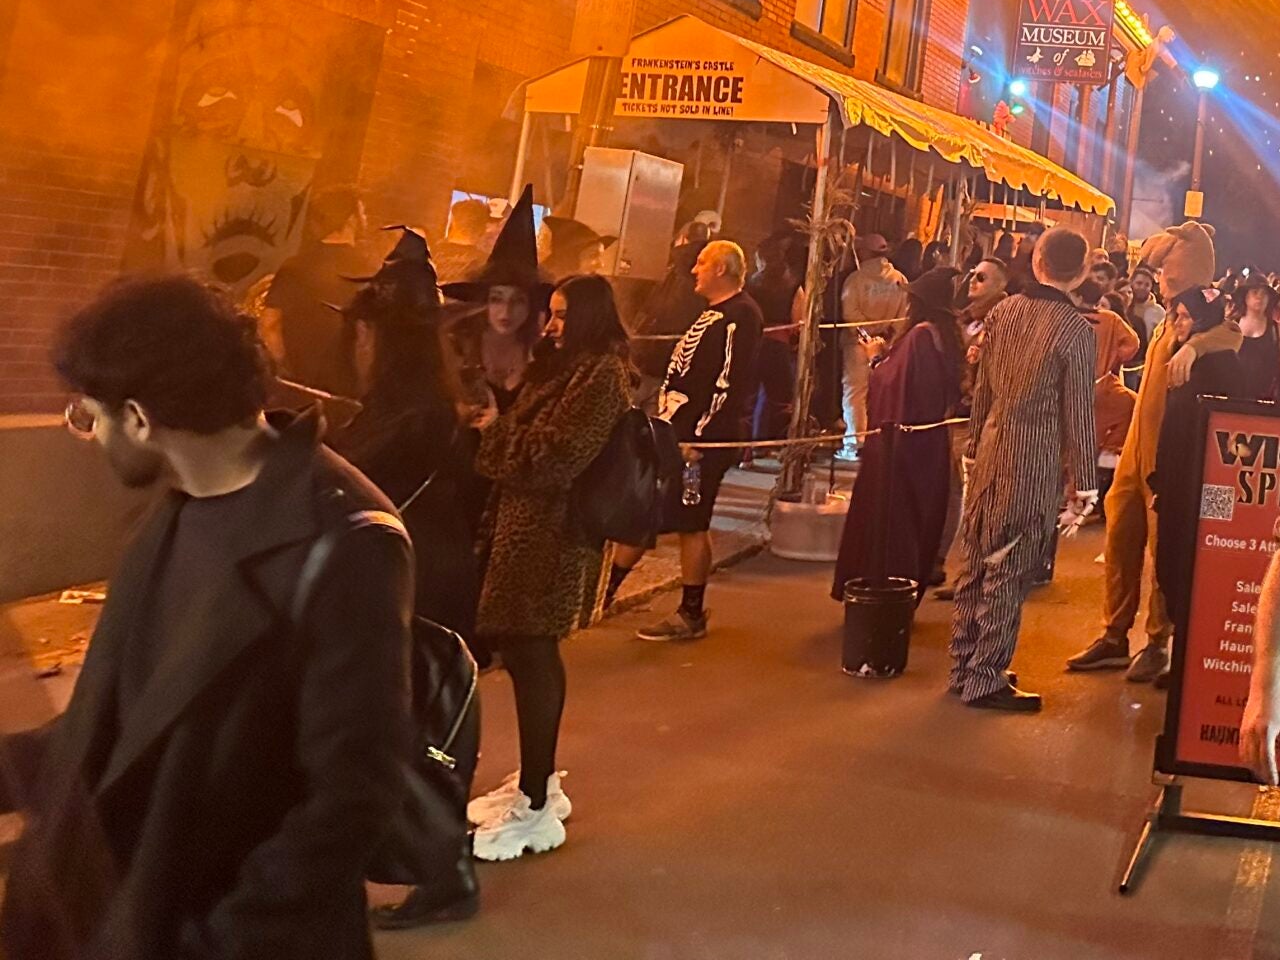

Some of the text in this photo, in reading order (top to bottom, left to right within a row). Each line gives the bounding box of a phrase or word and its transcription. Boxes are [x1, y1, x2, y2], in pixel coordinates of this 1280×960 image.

[1020, 26, 1106, 46] MUSEUM
[1053, 48, 1070, 66] of
[631, 58, 735, 71] FRANKENSTEIN'S CASTLE
[620, 72, 744, 104] ENTRANCE
[622, 103, 734, 117] TICKETS NOT SOLD IN LINE!
[1205, 534, 1247, 549] Choose
[1249, 539, 1257, 550] 3
[1236, 581, 1261, 593] Sale
[1231, 601, 1258, 614] Sale
[1224, 620, 1252, 634] Fran
[1220, 640, 1254, 653] Haun
[1203, 657, 1252, 673] Witchin
